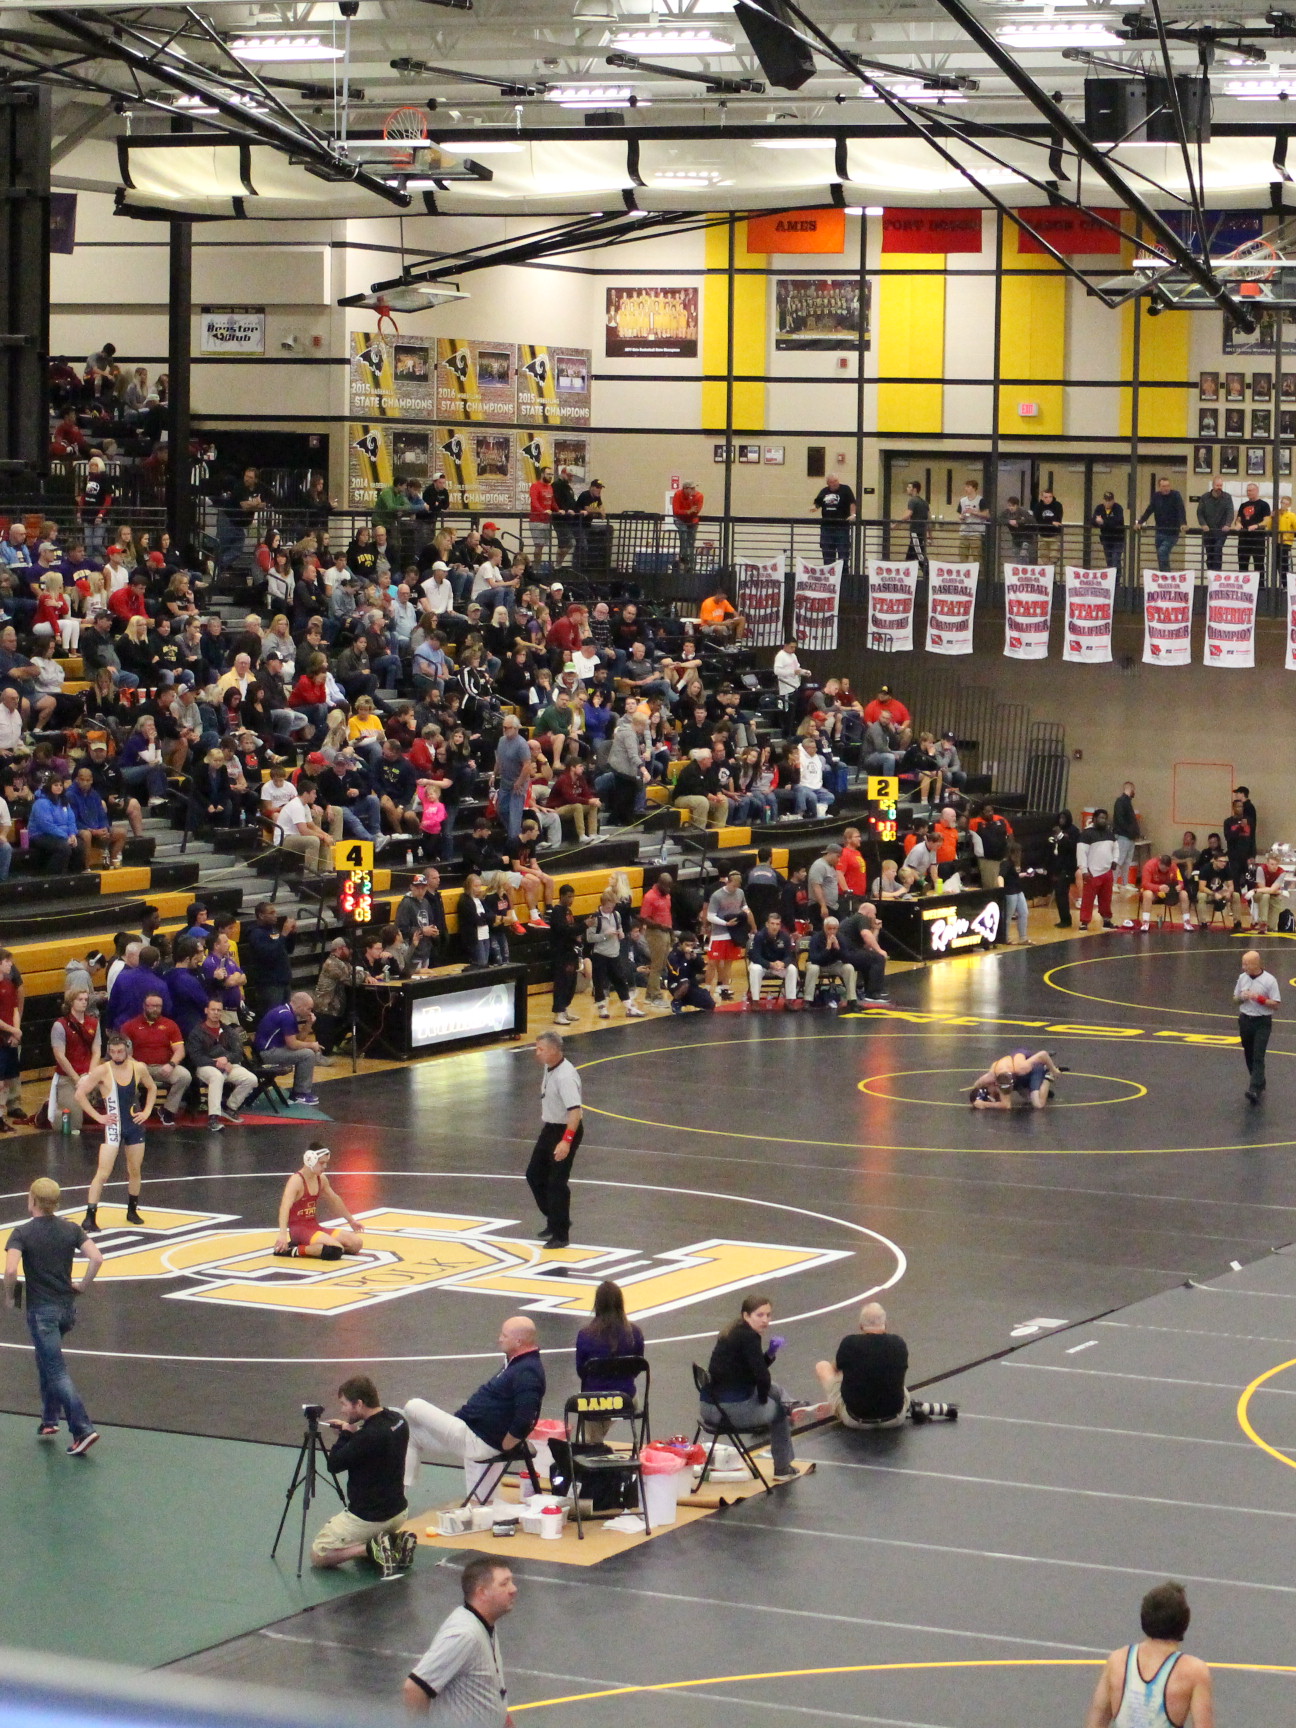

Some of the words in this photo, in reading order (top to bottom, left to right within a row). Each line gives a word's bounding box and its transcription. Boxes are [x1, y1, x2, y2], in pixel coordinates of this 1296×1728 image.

[775, 220, 817, 232] AMES
[352, 383, 370, 394] 2015
[439, 388, 455, 398] 2016
[355, 397, 380, 407] STATE
[382, 398, 432, 410] CHAMPIONS
[519, 393, 535, 403] 2015
[441, 401, 464, 411] STATE
[466, 402, 513, 413] CHAMPIONS
[521, 406, 543, 416] STATE
[545, 407, 589, 418] CHAMPIONS
[352, 478, 368, 488] 2014
[464, 493, 509, 504] CHAMPIONS
[876, 567, 911, 577] 2014
[936, 567, 971, 578] 2014
[1011, 568, 1046, 577] 2014
[871, 583, 913, 595] BASEBALL
[932, 585, 973, 598] BASEBALL
[1007, 583, 1049, 596] FOOTBALL
[1147, 590, 1189, 604] BOWLING
[872, 597, 912, 614] STATE
[932, 599, 972, 616] STATE
[1008, 600, 1049, 617] STATE
[1069, 602, 1111, 620] STATE
[1146, 605, 1189, 623] STATE
[1209, 606, 1253, 624] DISTRICT
[877, 779, 889, 796] 2
[889, 810, 896, 819] 0
[347, 846, 362, 866] 4
[351, 871, 370, 882] 125
[345, 882, 353, 893] 0
[355, 909, 371, 921] 03
[333, 1258, 477, 1287] POLK
[578, 1397, 623, 1411] RAMS
